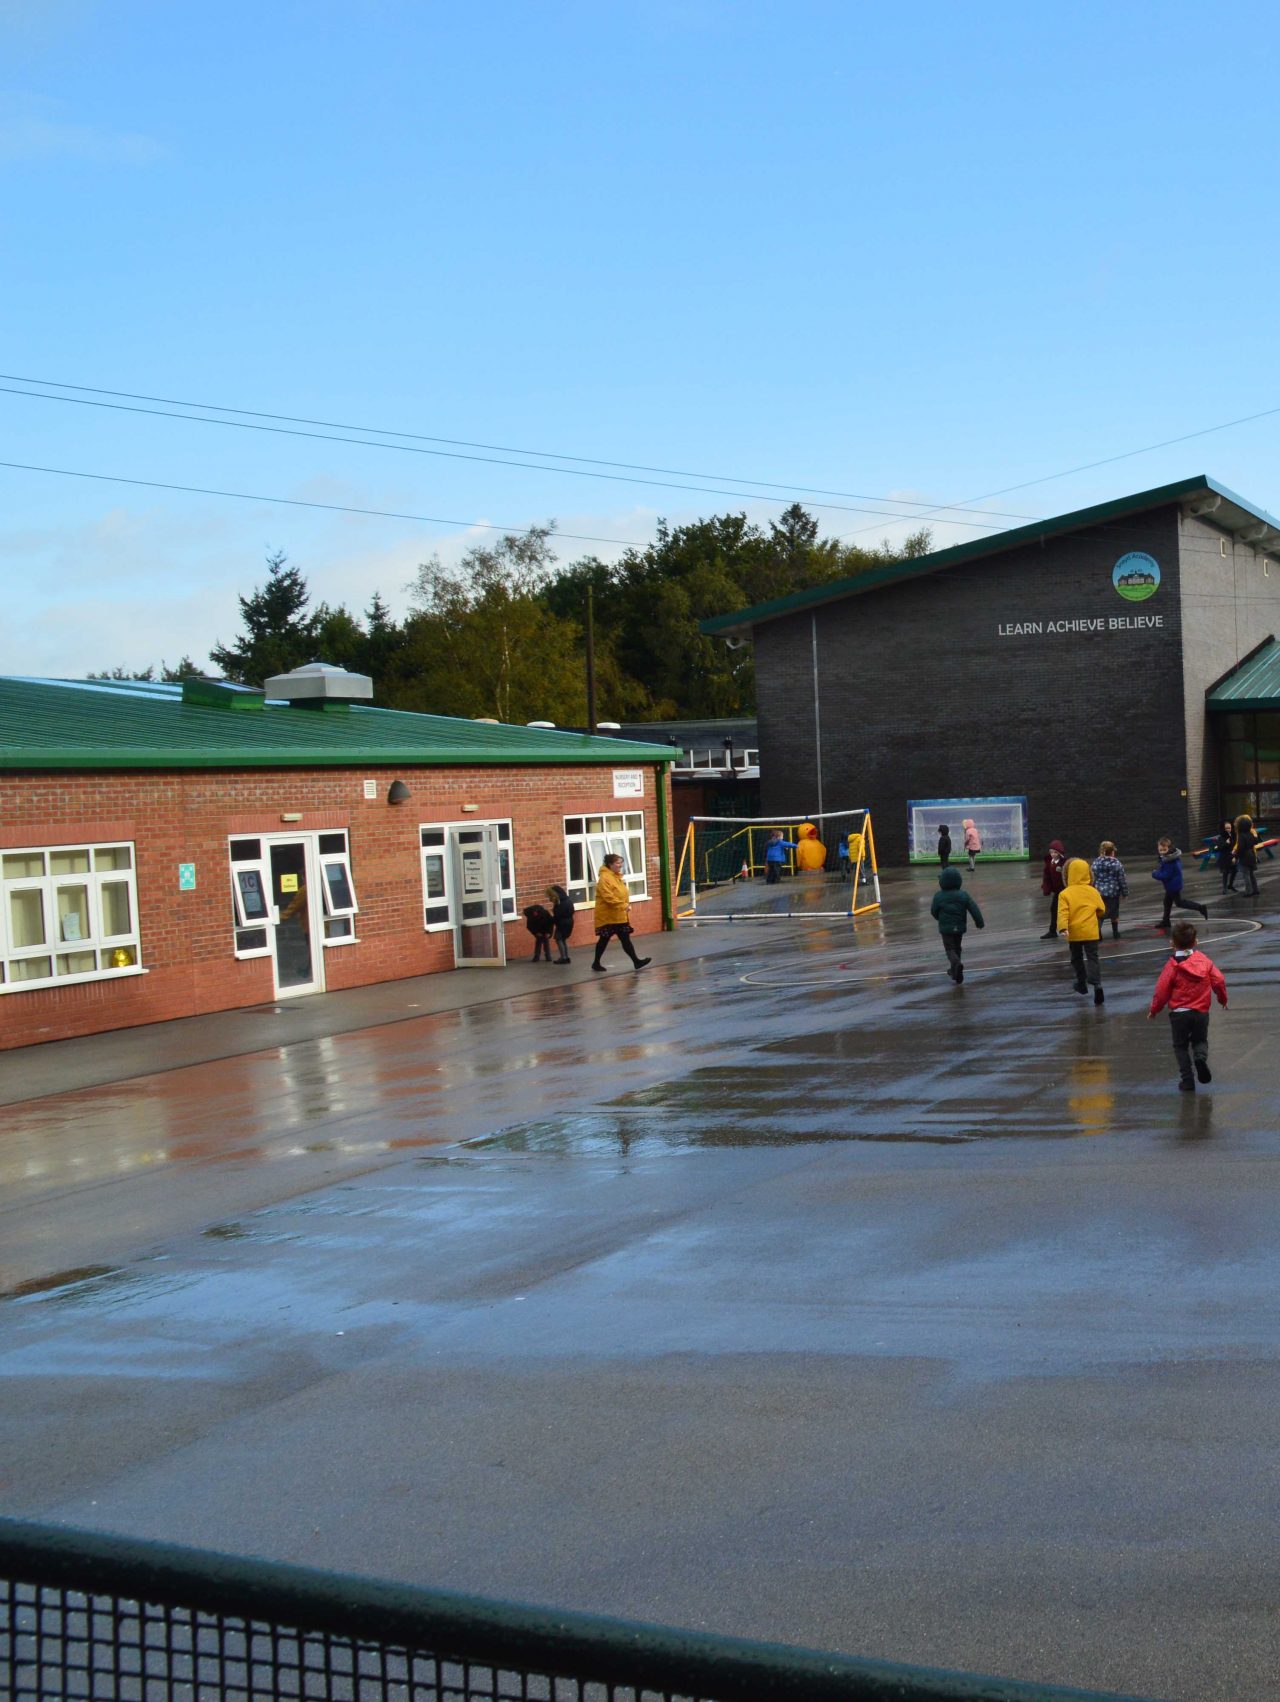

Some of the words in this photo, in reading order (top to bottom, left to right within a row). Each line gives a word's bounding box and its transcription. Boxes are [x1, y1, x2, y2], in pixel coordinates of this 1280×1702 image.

[998, 621, 1043, 636] LEARN
[1047, 618, 1105, 633] ACHIEVE
[1108, 615, 1164, 630] BELIEVE
